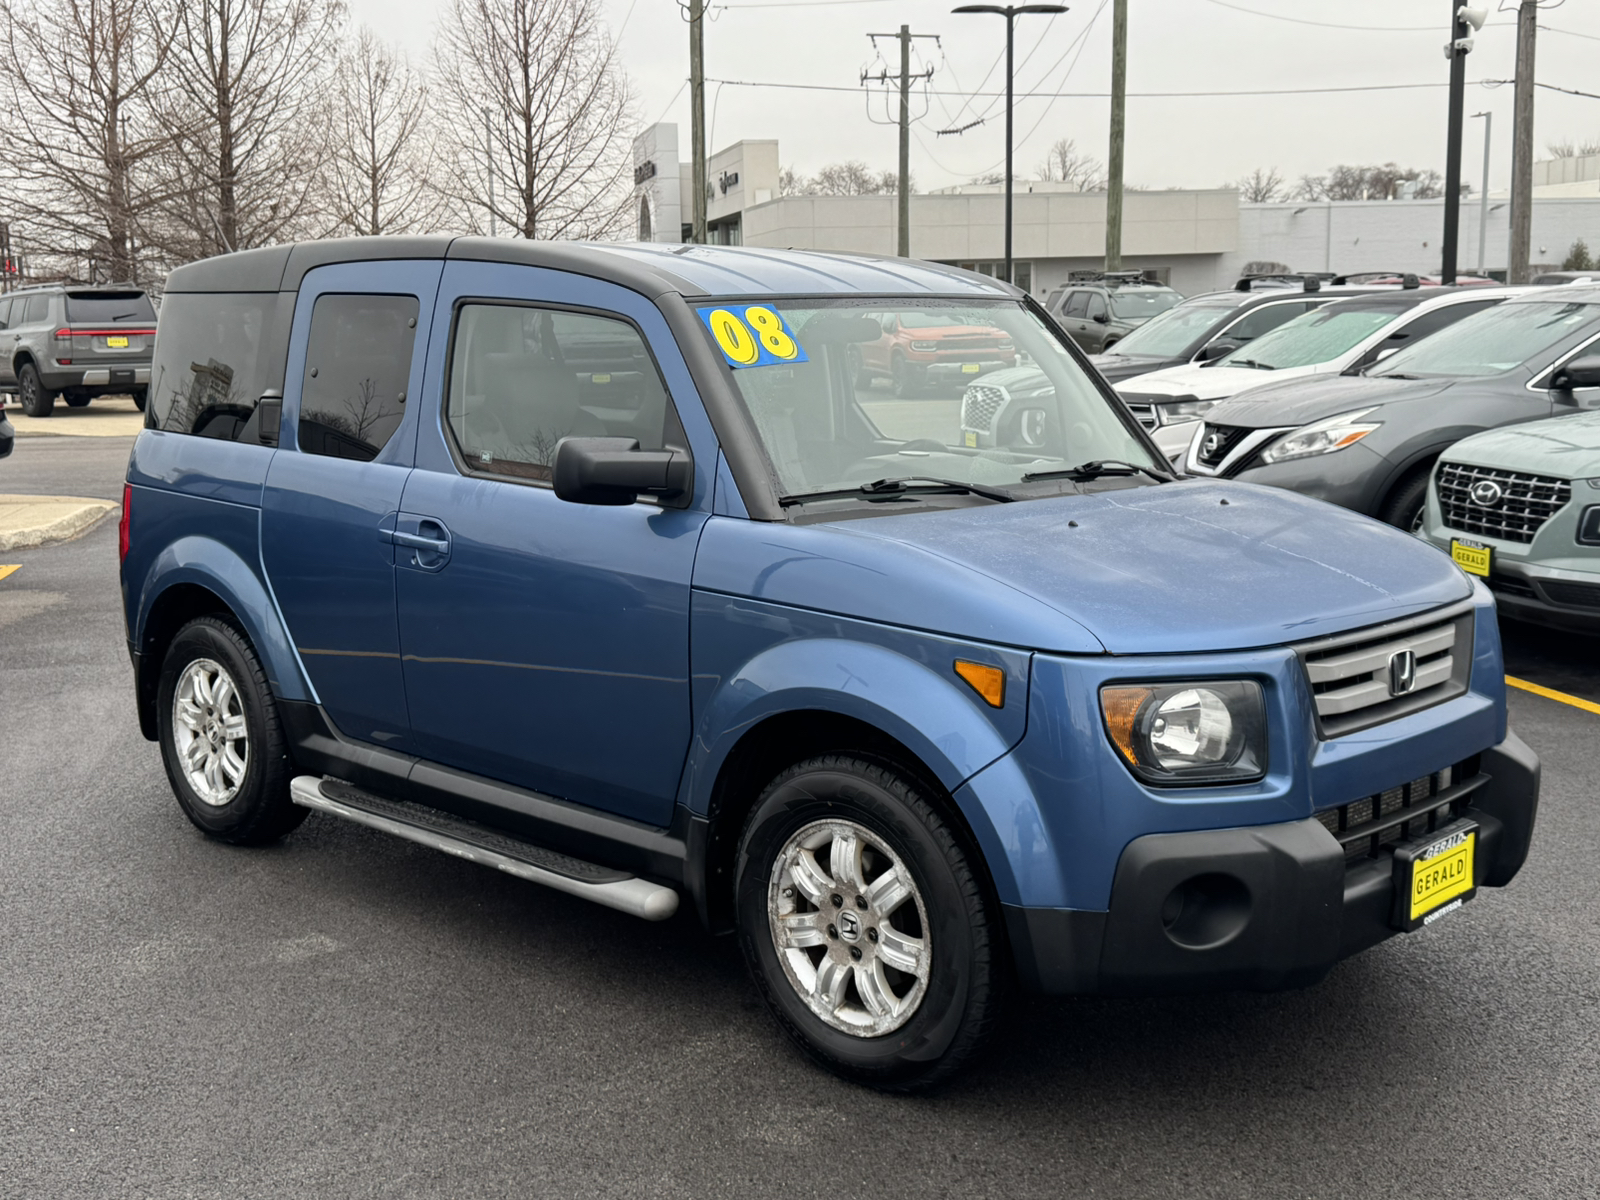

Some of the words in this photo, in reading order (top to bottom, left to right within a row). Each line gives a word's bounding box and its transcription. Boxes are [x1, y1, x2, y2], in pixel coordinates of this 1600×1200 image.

[709, 306, 799, 365] 08
[1457, 551, 1485, 566] GERALD
[1424, 832, 1467, 859] GERALD
[1416, 859, 1464, 895] GERALD
